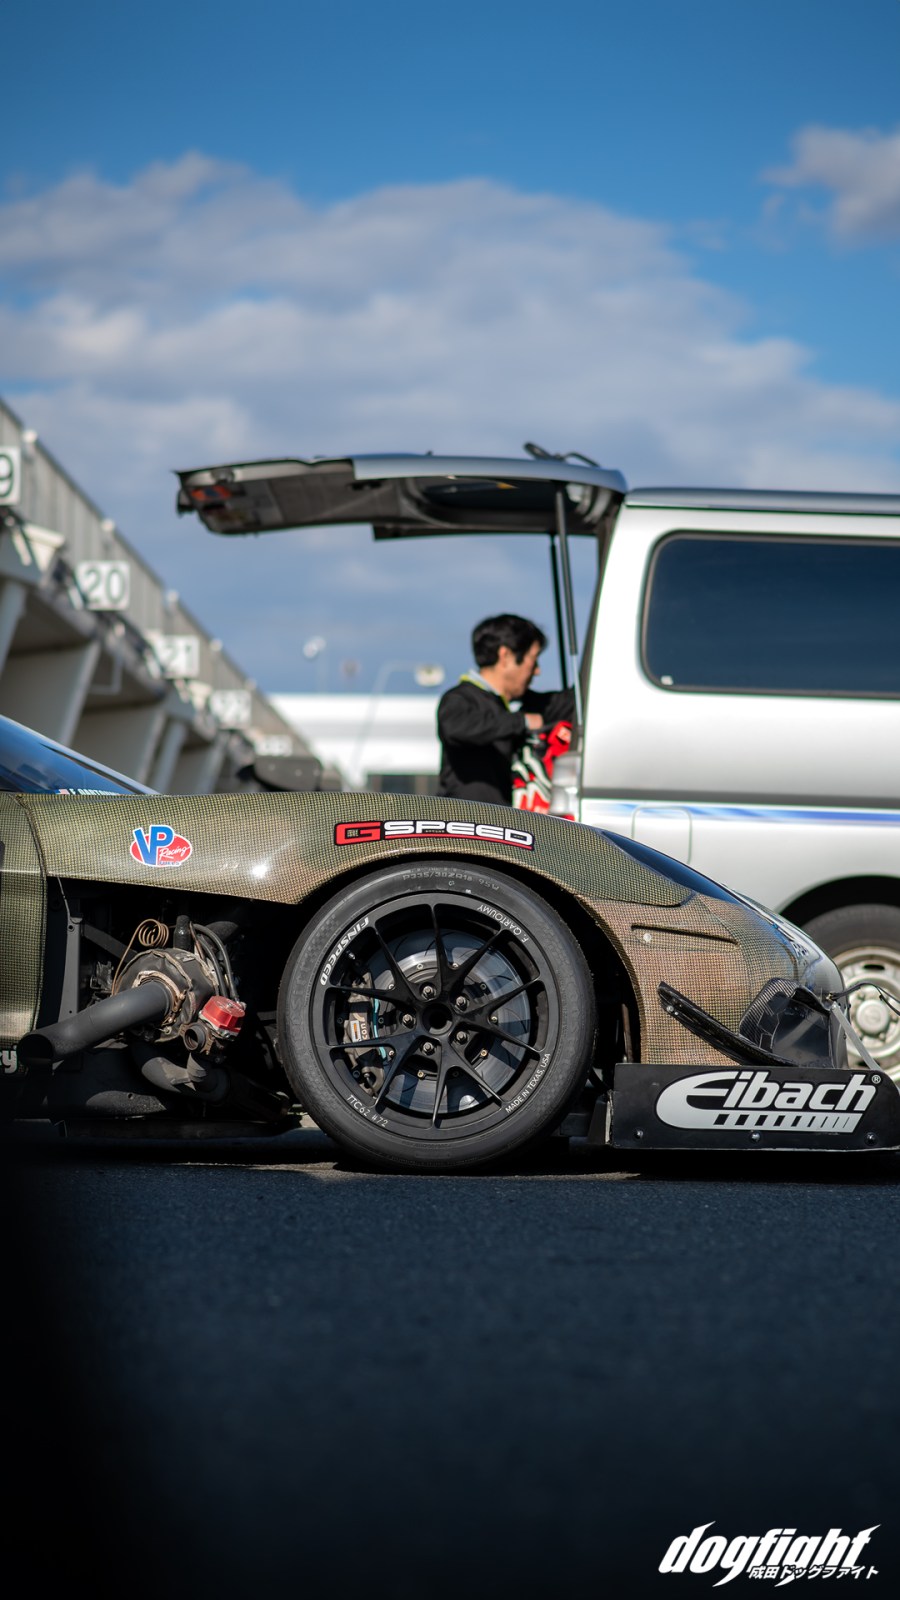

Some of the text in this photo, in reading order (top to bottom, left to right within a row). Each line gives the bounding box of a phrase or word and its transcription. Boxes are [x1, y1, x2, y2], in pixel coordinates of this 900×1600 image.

[82, 566, 125, 605] 20
[132, 825, 175, 866] VP
[158, 845, 191, 860] Racing
[477, 904, 522, 936] QARTOUMY
[505, 1053, 551, 1114] MADE IN TEXAS, USA
[656, 1070, 877, 1133] Eibach
